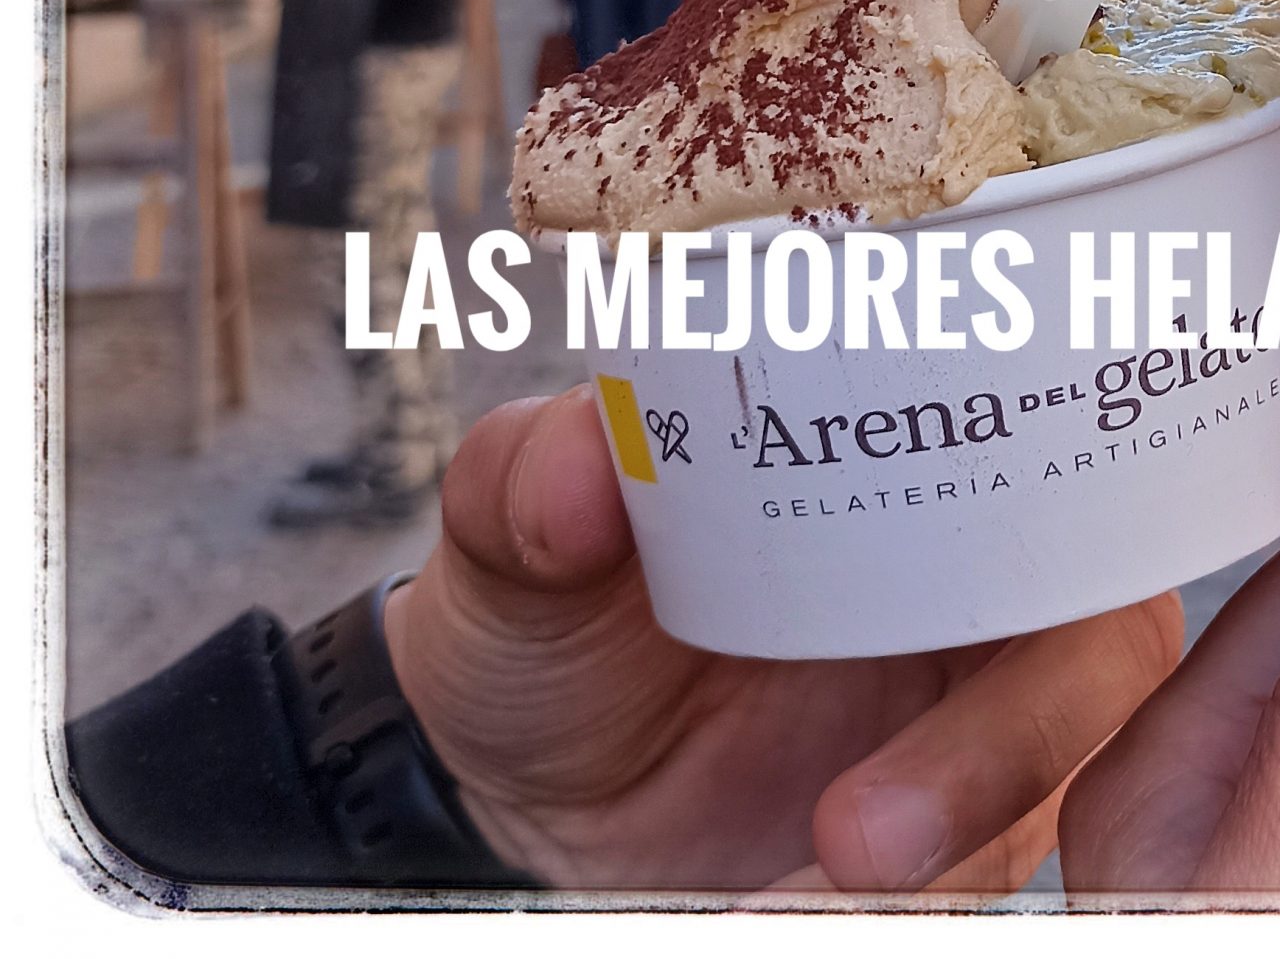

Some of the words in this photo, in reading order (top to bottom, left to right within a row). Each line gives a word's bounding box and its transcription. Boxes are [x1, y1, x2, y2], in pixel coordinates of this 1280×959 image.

[1019, 383, 1086, 413] DEL
[762, 472, 1010, 518] GELATERIA
[1043, 378, 1280, 480] ARTIGIANALE
